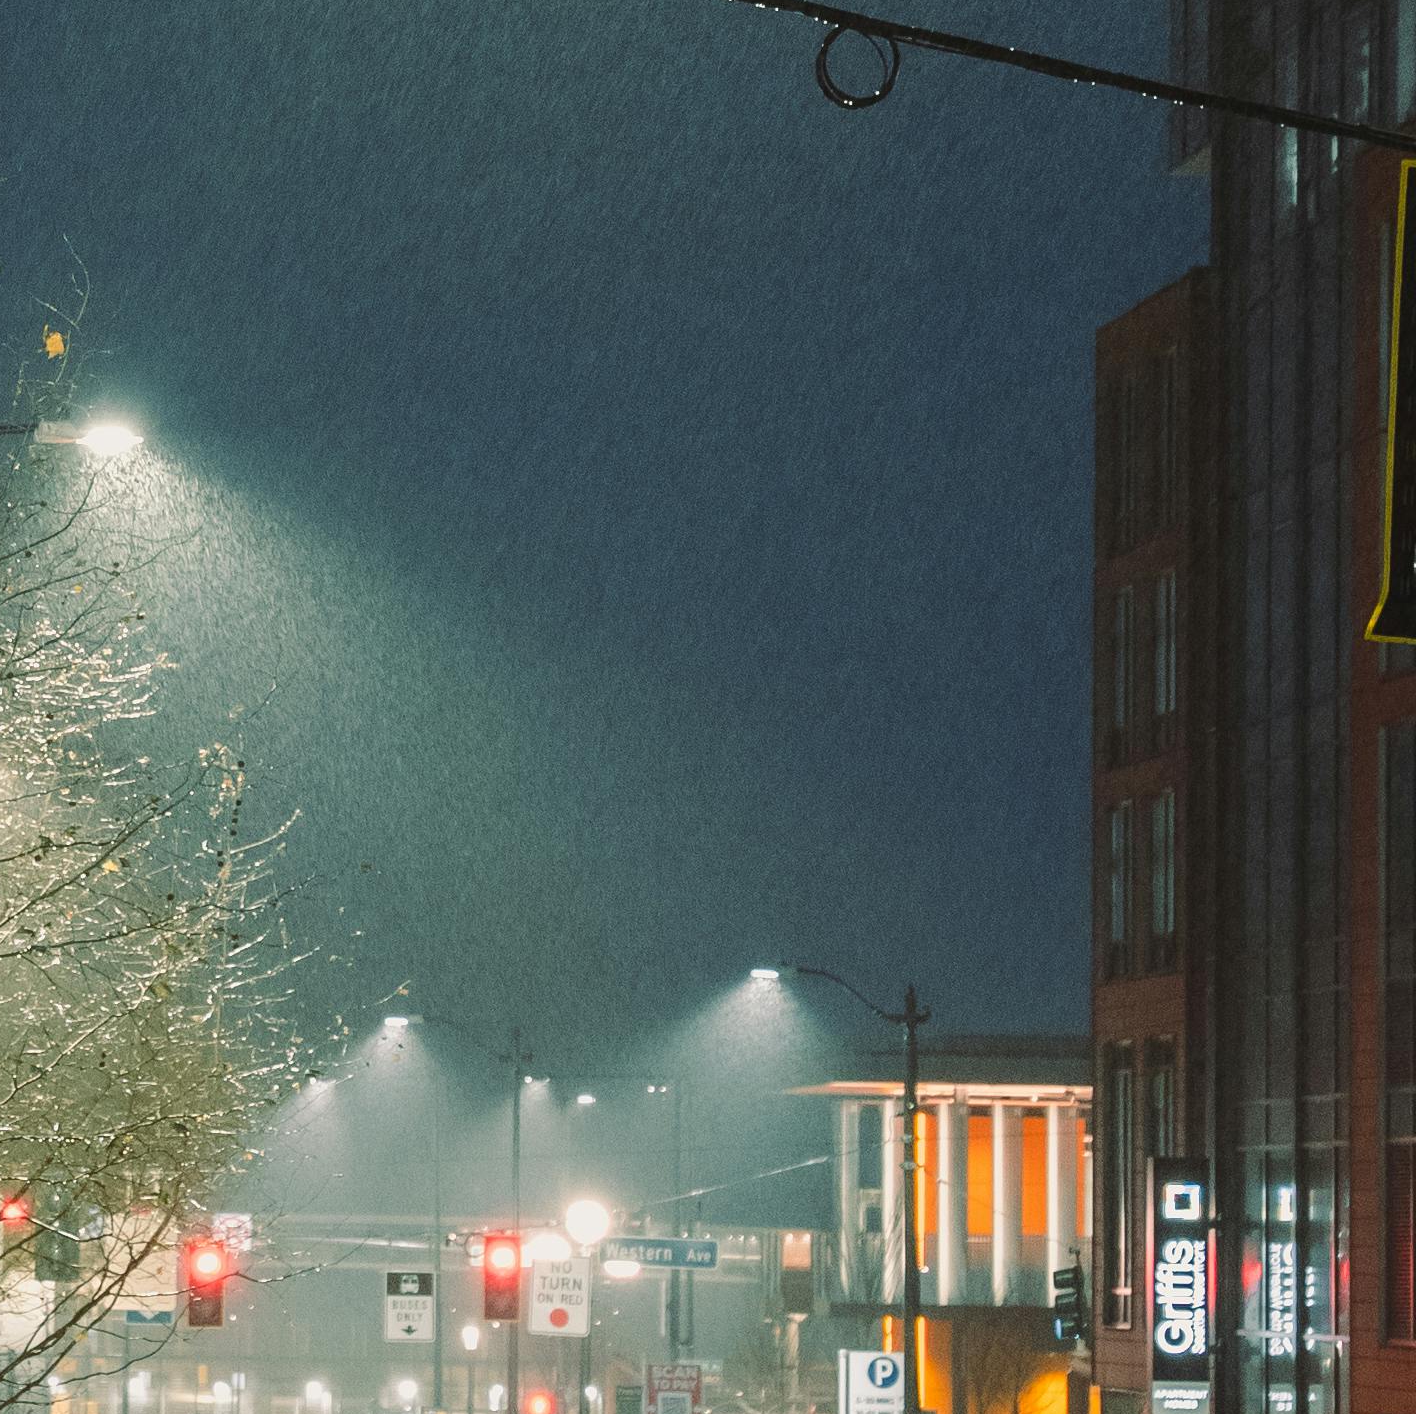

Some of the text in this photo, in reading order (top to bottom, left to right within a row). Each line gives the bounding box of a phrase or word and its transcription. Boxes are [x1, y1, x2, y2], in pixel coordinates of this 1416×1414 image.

[605, 1242, 712, 1261] Western Ave
[549, 1260, 573, 1274] NO
[539, 1276, 583, 1291] TURN
[537, 1293, 584, 1306] ON RED
[1155, 1239, 1194, 1355] Griffis
[392, 1299, 429, 1310] BUSES
[396, 1312, 423, 1322] ONLY
[652, 1366, 697, 1378] SCAN
[875, 1358, 894, 1387] P
